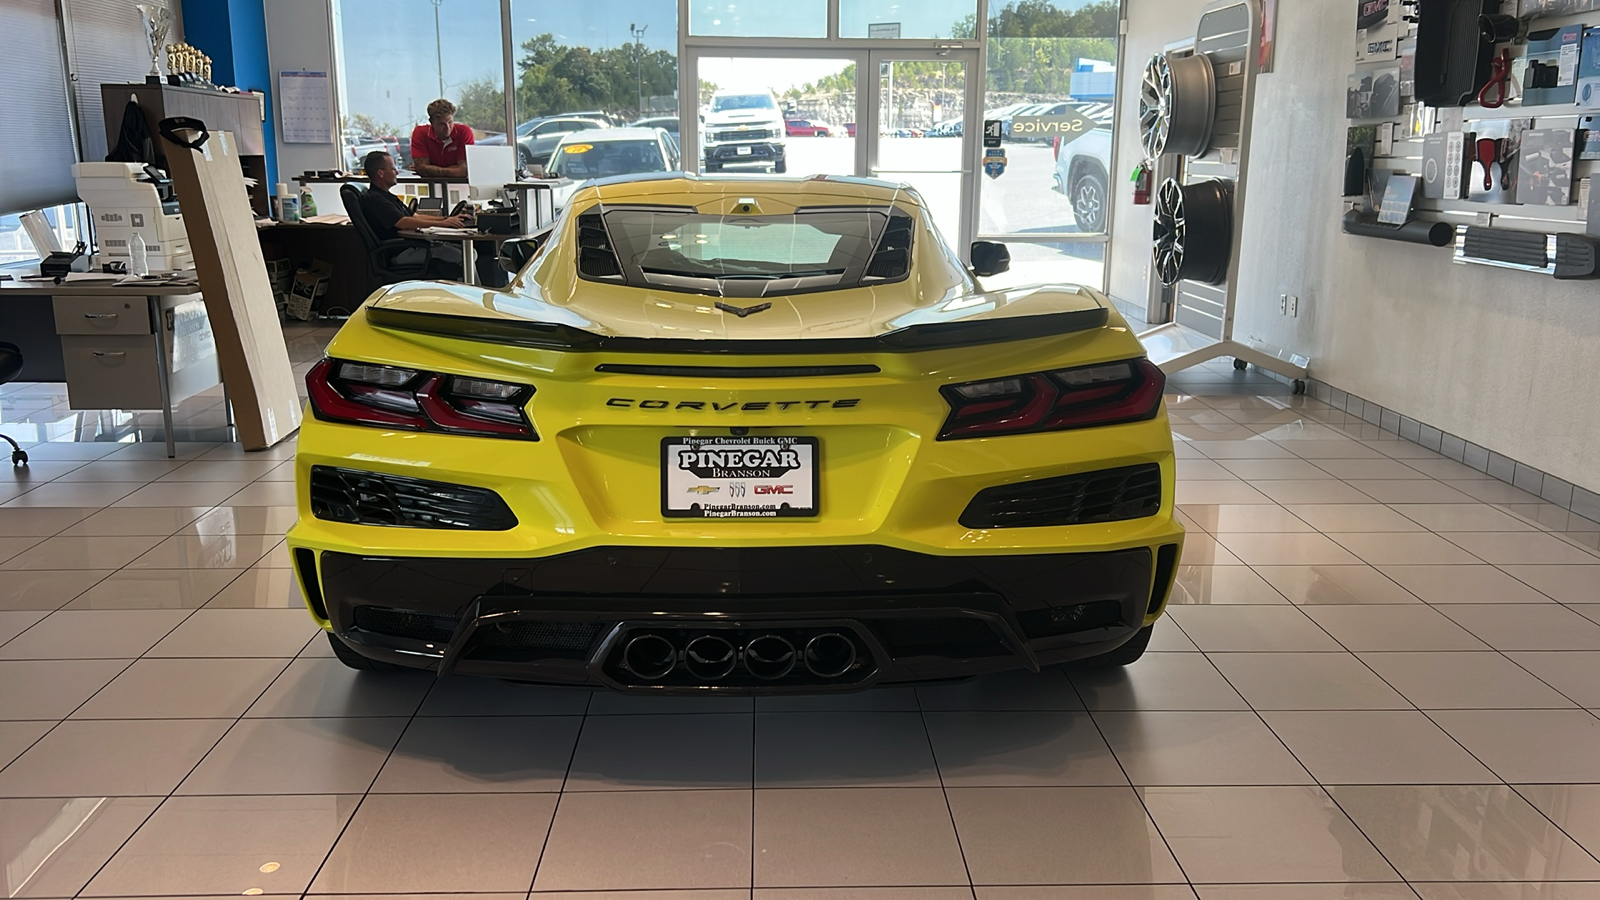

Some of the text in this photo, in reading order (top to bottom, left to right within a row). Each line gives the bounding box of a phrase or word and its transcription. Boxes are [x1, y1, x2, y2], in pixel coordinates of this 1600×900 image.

[1367, 40, 1392, 54] GMC
[606, 398, 860, 411] CORVETTE
[683, 437, 713, 445] Pinegar
[714, 437, 751, 445] Chevrolet
[680, 451, 799, 468] PINEGAR
[713, 468, 771, 477] BRANSON
[754, 485, 793, 494] GMC
[704, 510, 776, 518] PinegarBranson.com
